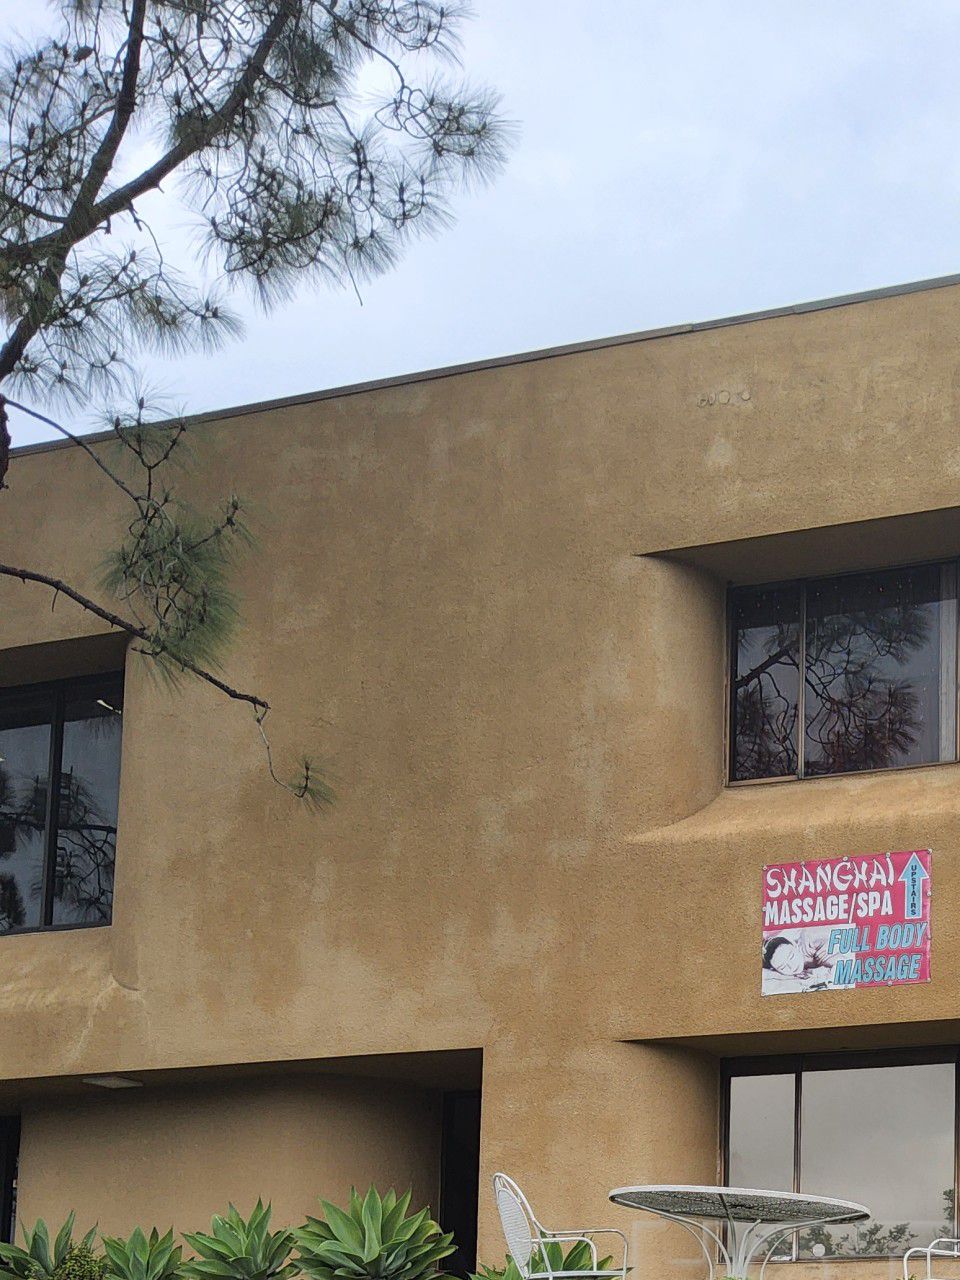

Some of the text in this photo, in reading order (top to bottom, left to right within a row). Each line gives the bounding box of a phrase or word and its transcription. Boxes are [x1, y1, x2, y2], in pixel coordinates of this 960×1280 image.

[766, 857, 895, 898] SHANGHAI
[827, 922, 928, 954] FULL BODY
[833, 954, 922, 985] MASSAGE
